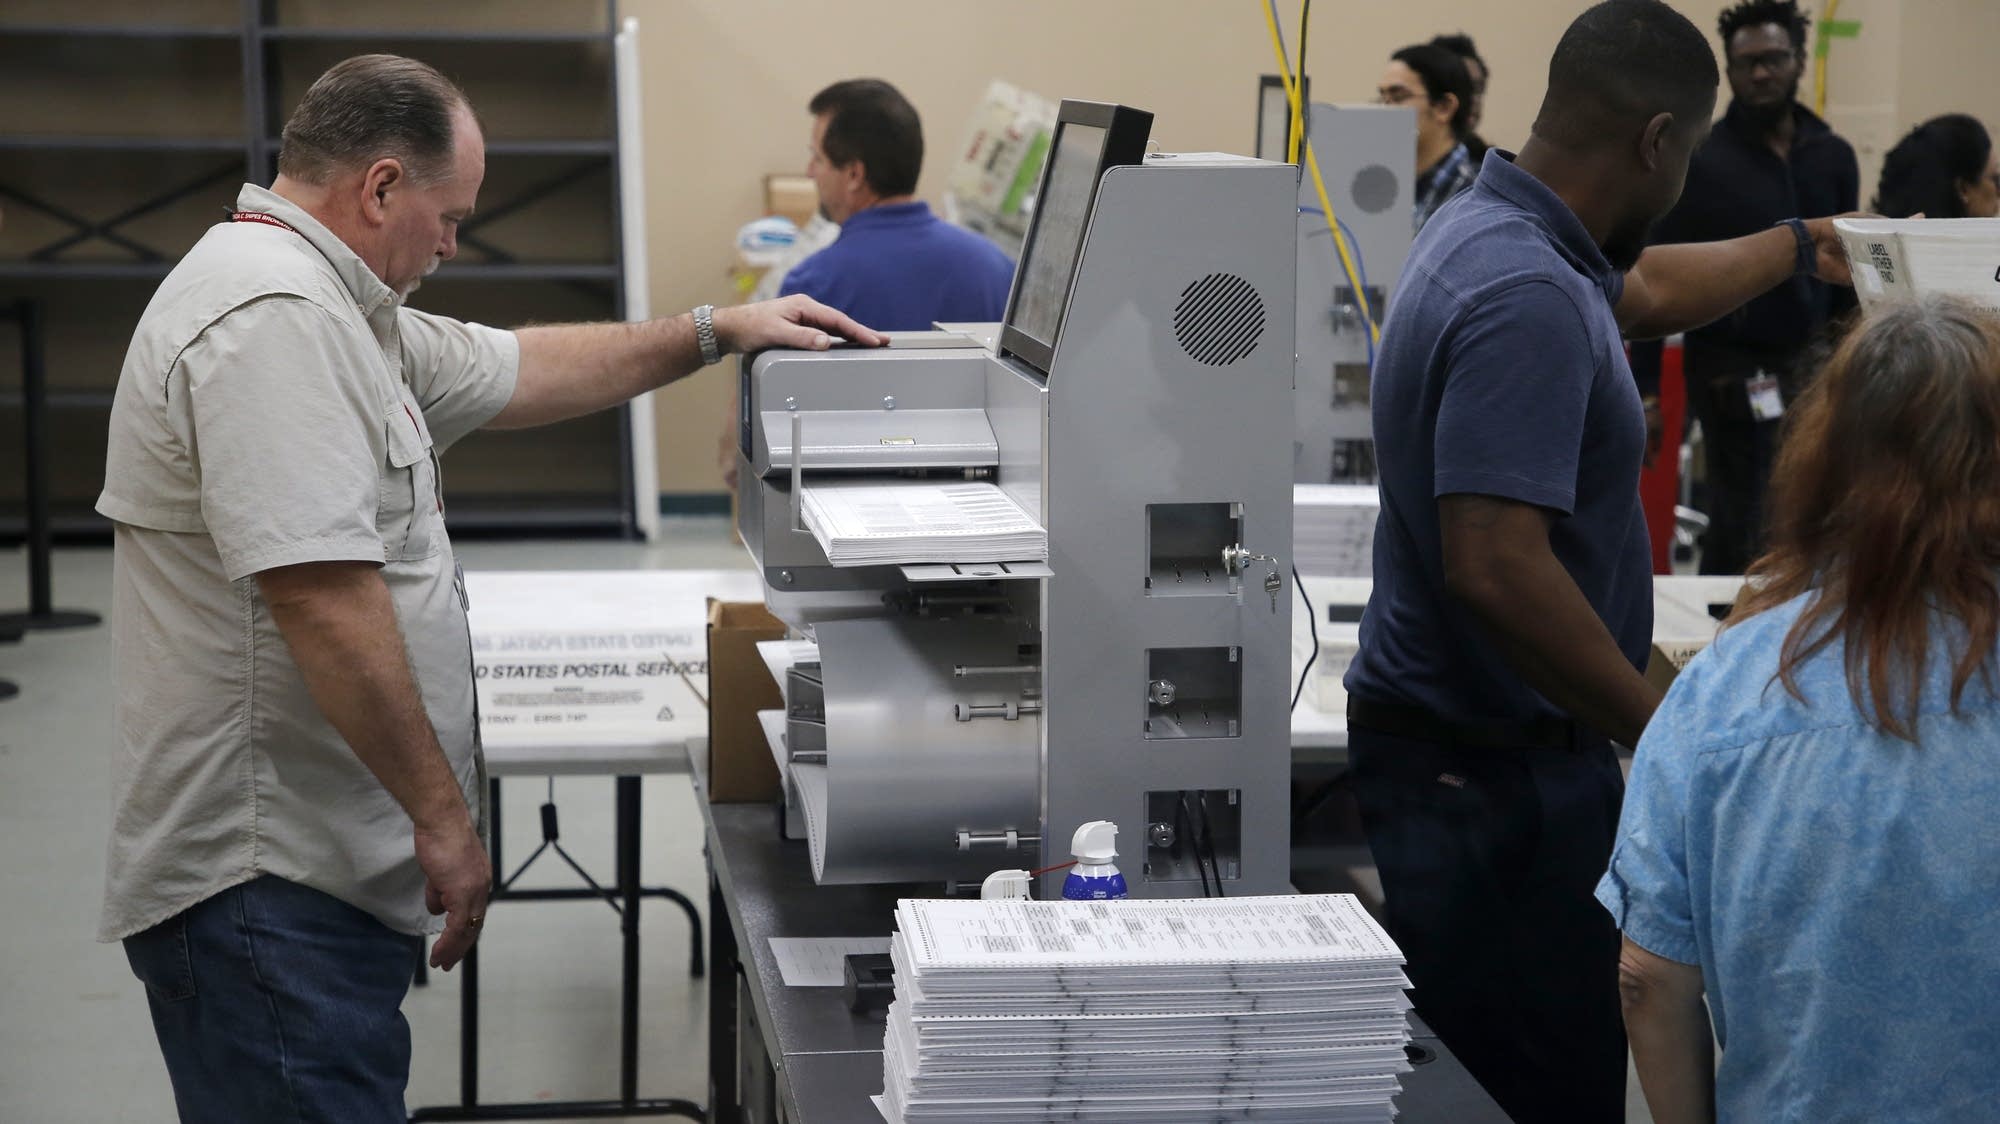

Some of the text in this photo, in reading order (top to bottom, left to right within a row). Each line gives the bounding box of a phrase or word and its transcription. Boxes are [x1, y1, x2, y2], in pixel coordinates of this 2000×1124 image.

[1867, 242, 1889, 256] LABEL
[1872, 257, 1895, 270] OTHER
[1880, 270, 1895, 284] END
[492, 663, 558, 679] STATES
[563, 662, 630, 678] POSTAL
[635, 661, 708, 677] SERVICE
